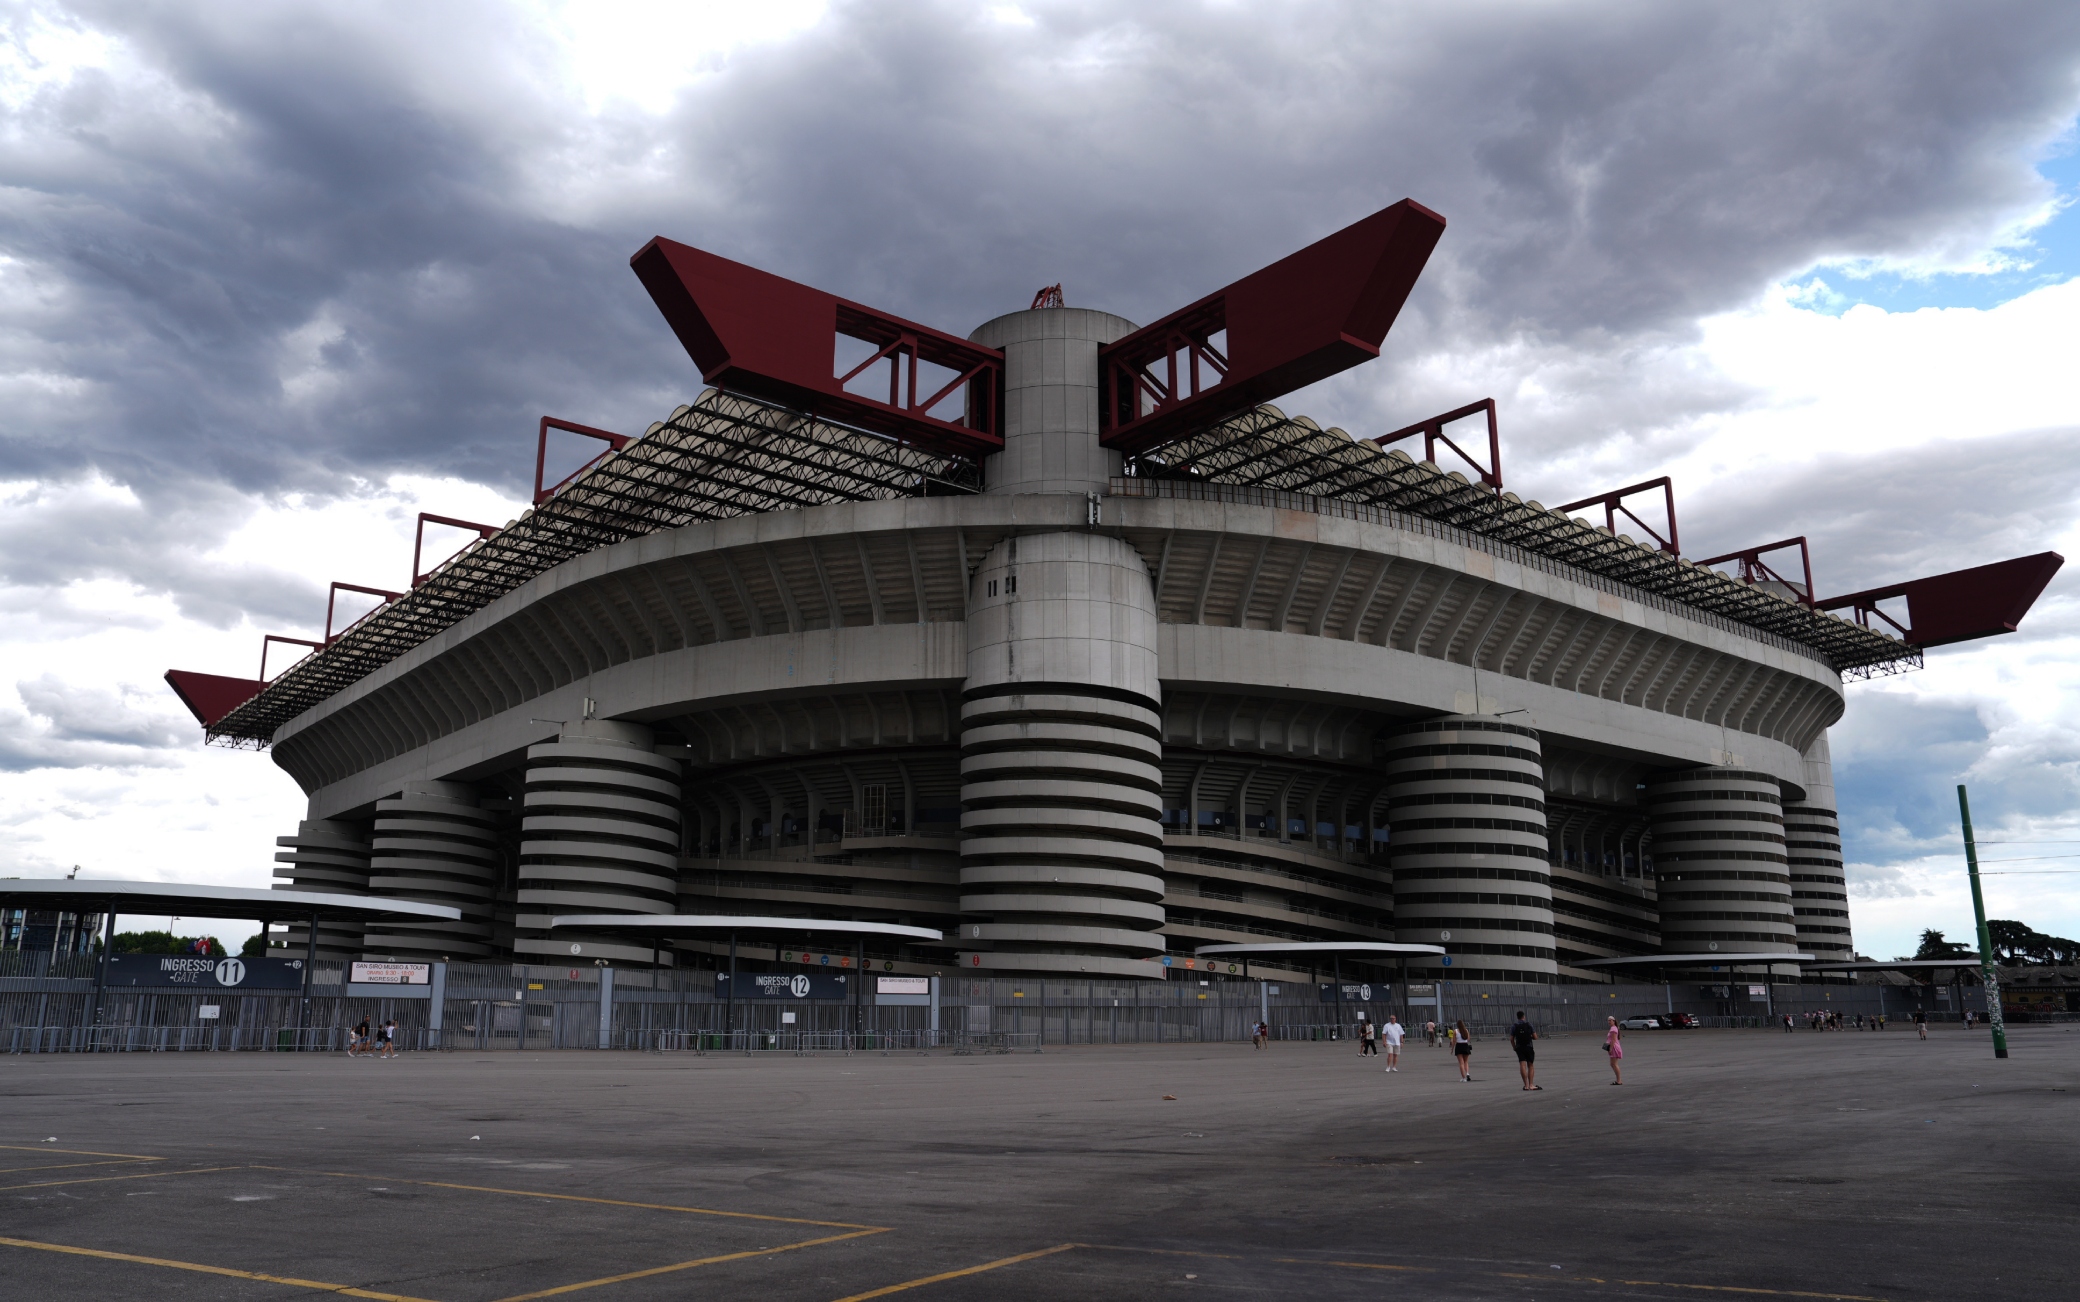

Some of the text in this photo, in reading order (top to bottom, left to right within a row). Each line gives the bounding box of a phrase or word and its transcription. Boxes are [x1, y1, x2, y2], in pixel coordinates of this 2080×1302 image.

[160, 958, 239, 982] INGRESSO 11
[173, 972, 199, 983] GATE
[756, 976, 807, 994] INGRESSO 12
[764, 986, 780, 995] GATE
[1362, 986, 1369, 998] 13
